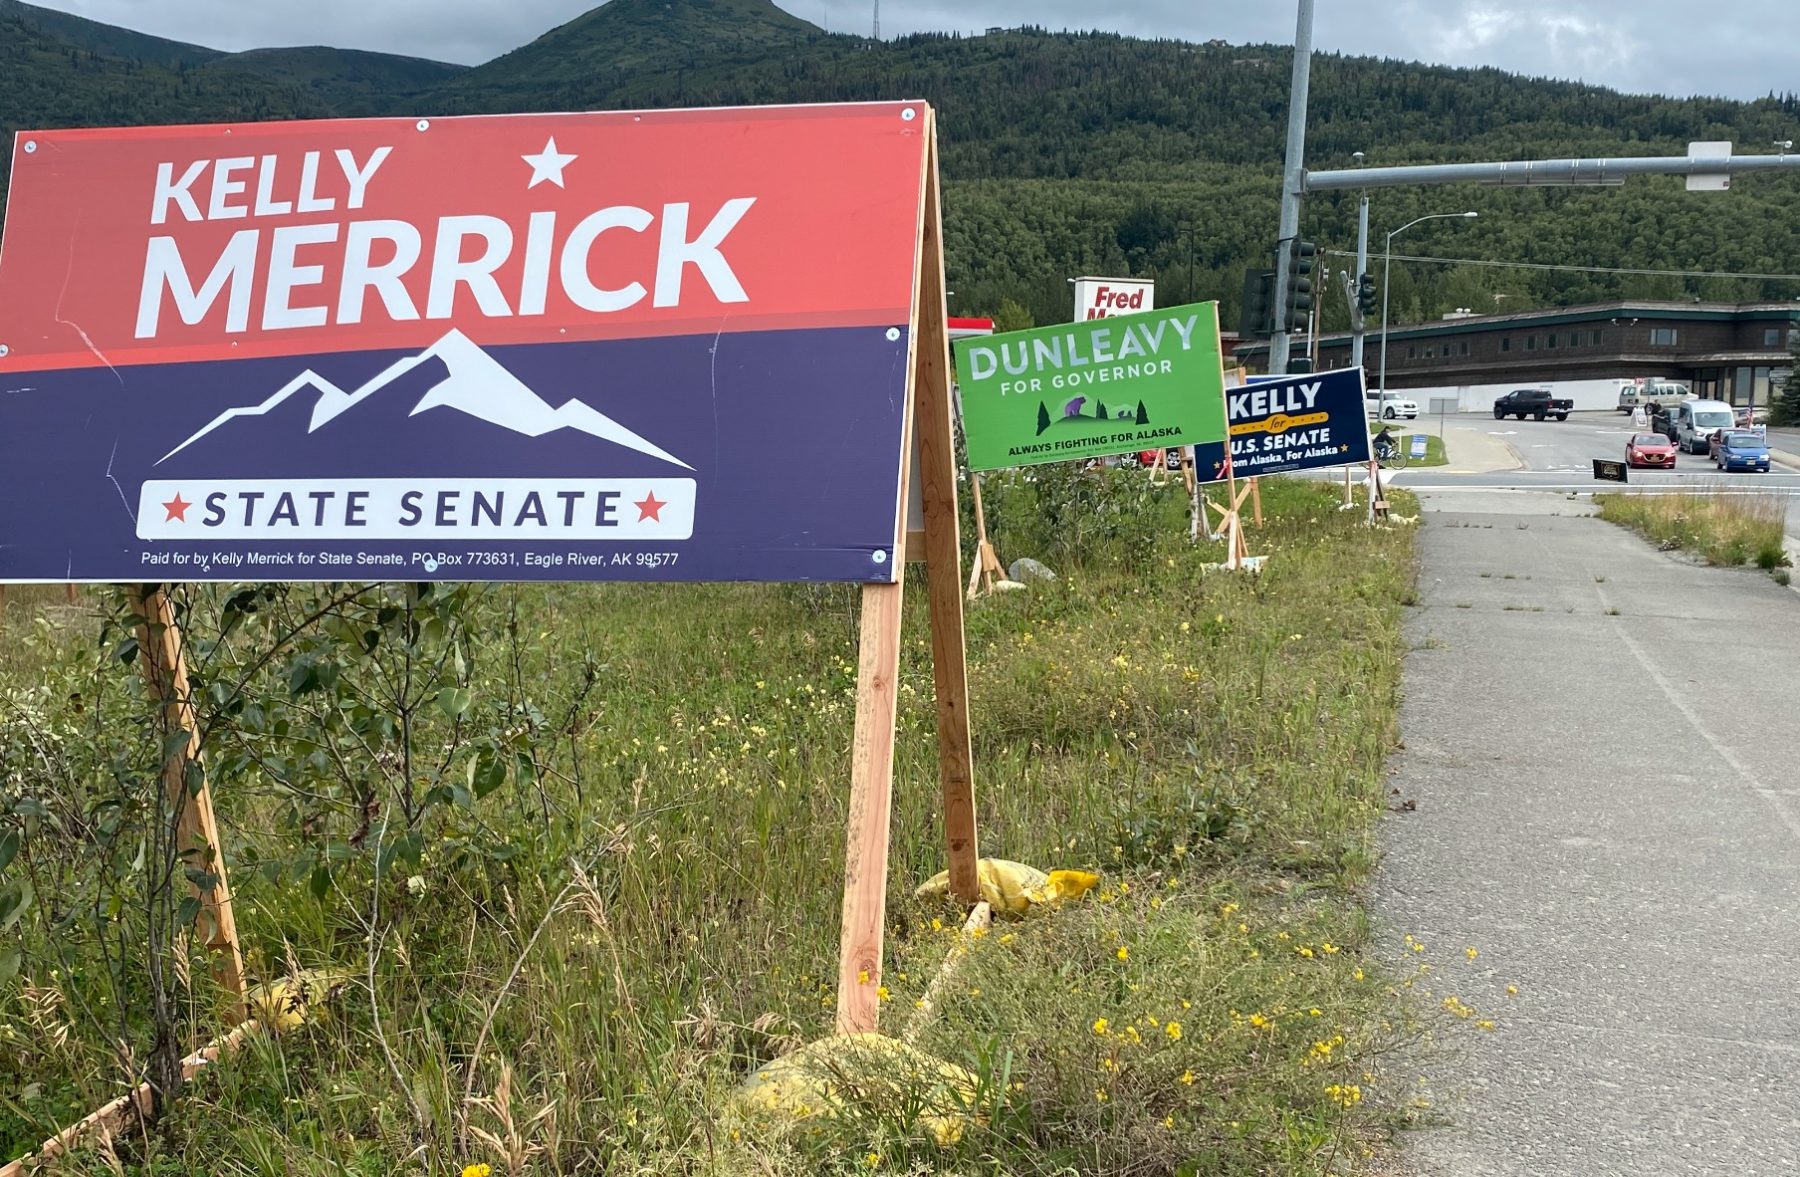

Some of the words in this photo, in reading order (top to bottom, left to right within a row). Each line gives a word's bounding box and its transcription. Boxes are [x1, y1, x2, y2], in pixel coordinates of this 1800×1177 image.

[151, 146, 394, 225] KELLY
[134, 196, 758, 339] MERRICK
[1095, 286, 1144, 309] Fred
[969, 315, 1198, 380] DUNLEAVY
[1001, 378, 1042, 396] FOR
[1052, 359, 1172, 389] GOVERNOR
[1229, 381, 1322, 420] KELLY
[1270, 416, 1286, 430] for
[1008, 443, 1052, 456] ALWAYS
[1055, 435, 1108, 450] FIGHTING
[1111, 431, 1133, 443] FOR
[1136, 426, 1182, 440] ALASKA
[1231, 439, 1260, 455] U.S.
[1263, 427, 1331, 451] SENATE
[1249, 452, 1285, 466] Alaska,
[1286, 450, 1303, 461] For
[1305, 446, 1338, 458] Alaska
[202, 491, 370, 527] STATE
[399, 491, 621, 527] SENATE
[141, 552, 169, 564] Paid
[173, 552, 190, 564] for
[193, 552, 209, 568] by
[212, 552, 243, 567] Kelly
[247, 552, 294, 564] Merrick
[298, 552, 315, 564] for
[318, 552, 353, 564] State
[356, 552, 407, 567] Senate,
[411, 552, 433, 565] PO
[437, 553, 462, 565] Box
[466, 552, 520, 567] 773631,
[524, 553, 563, 568] Eagle
[567, 553, 606, 567] River,
[611, 553, 632, 565] AK
[636, 553, 679, 565] 99577
